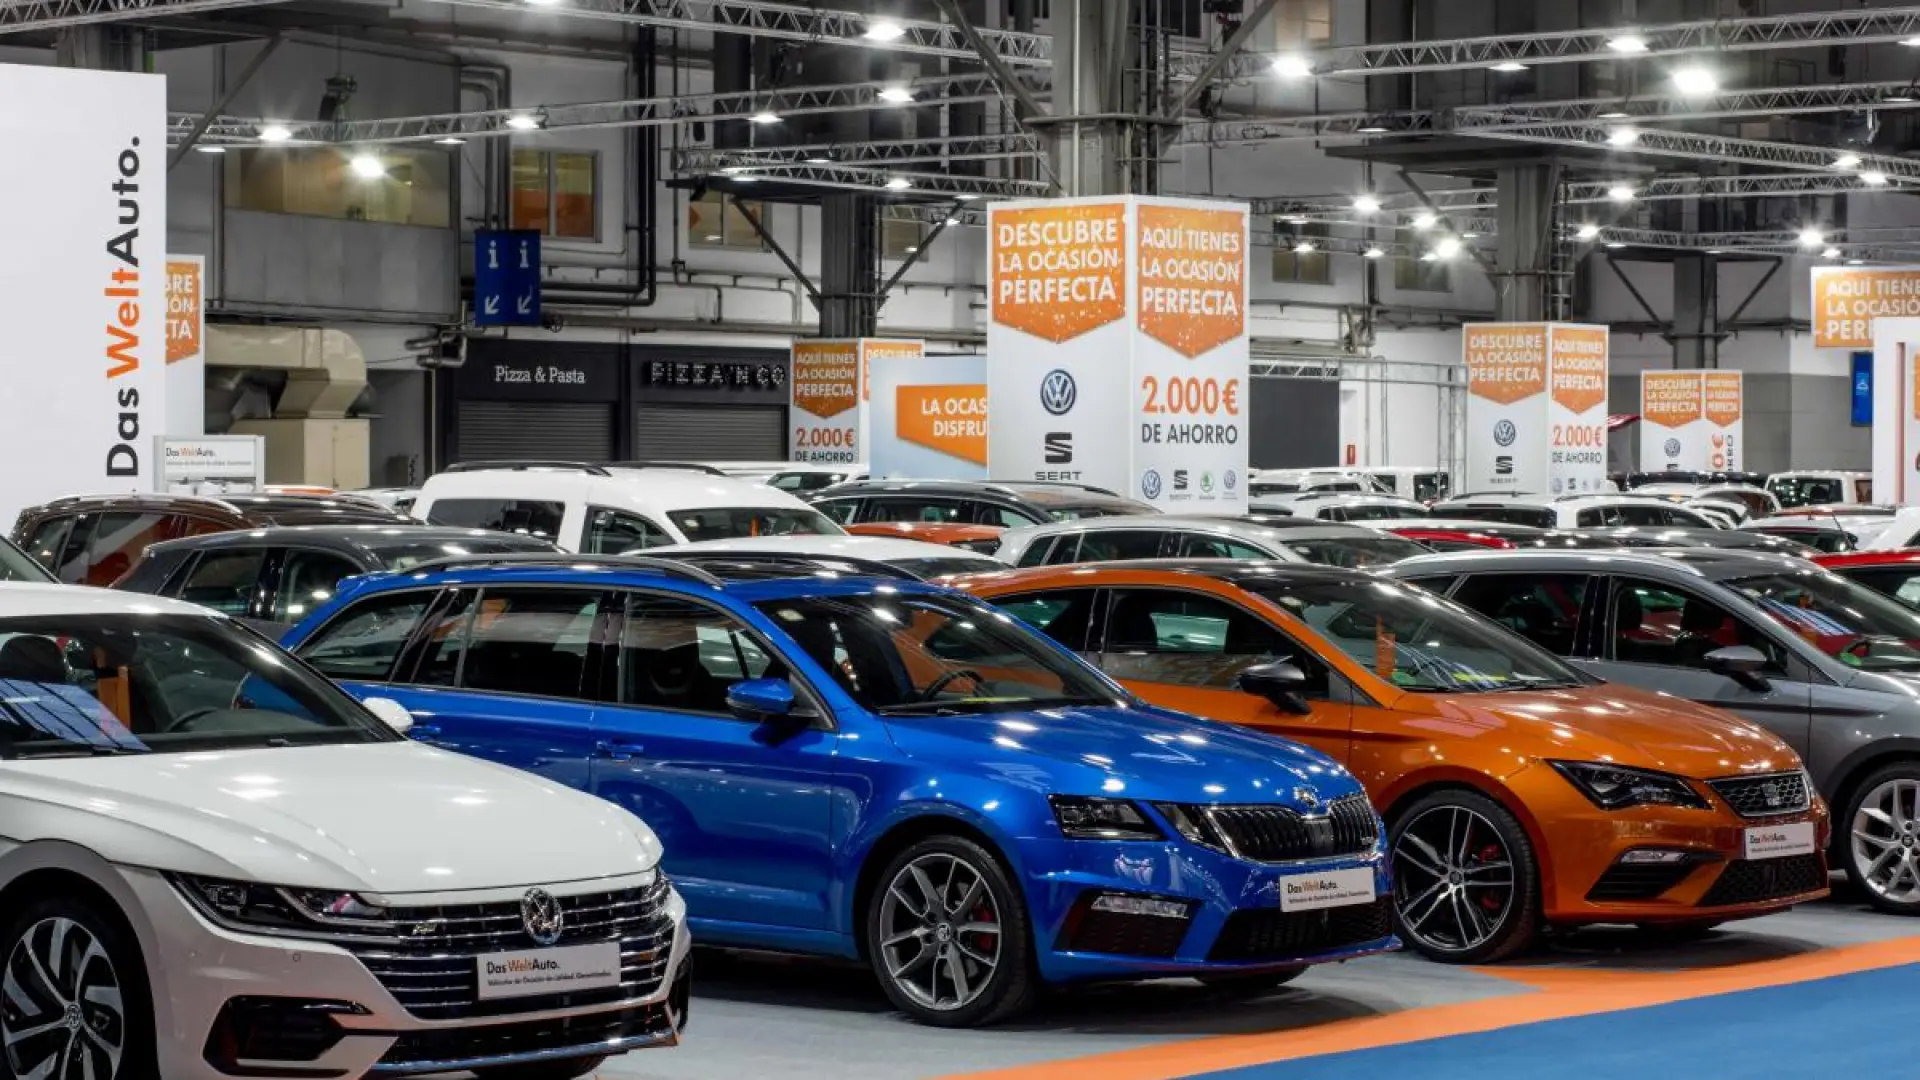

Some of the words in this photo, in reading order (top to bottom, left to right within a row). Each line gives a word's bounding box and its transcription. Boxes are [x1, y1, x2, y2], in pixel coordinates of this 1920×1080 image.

[999, 218, 1118, 247] DESCUBRE
[1141, 227, 1182, 249] AQUÍ
[1186, 230, 1240, 253] TIENES
[104, 136, 140, 379] WeltAuto.
[999, 252, 1023, 272] LA
[1028, 243, 1119, 272] OCASIÓN
[1141, 257, 1162, 278] LA
[1165, 258, 1240, 283] OCASIÓN
[1000, 276, 1117, 304] PERFECTA
[1827, 278, 1870, 297] AQUÍ
[1142, 288, 1238, 316] PERFECTA
[1827, 300, 1848, 316] LA
[1854, 295, 1920, 315] OCASIÓ
[166, 319, 193, 340] TA
[1470, 335, 1542, 349] DESCUBRE
[1469, 353, 1485, 364] LA
[495, 366, 532, 382] Pizza
[534, 366, 546, 383] &
[548, 367, 586, 384] Pasta
[797, 367, 809, 380] LA
[1471, 367, 1540, 382] PERFECTA
[797, 383, 854, 397] PERFECTA
[1142, 375, 1239, 415] 2.000€
[922, 398, 940, 415] LA
[944, 397, 987, 417] OCAS
[106, 387, 139, 476] Das
[796, 428, 854, 448] 2.000€
[933, 420, 987, 437] DISFRU
[1142, 423, 1161, 443] DE
[1166, 424, 1238, 444] AHORRO
[1553, 425, 1603, 447] 2.000€
[795, 451, 808, 463] DE
[811, 451, 854, 464] AHORRO
[1566, 452, 1602, 463] AHORRO
[1287, 883, 1302, 893] Das
[487, 960, 507, 974] Das
[508, 957, 560, 972] WeltAuto.
